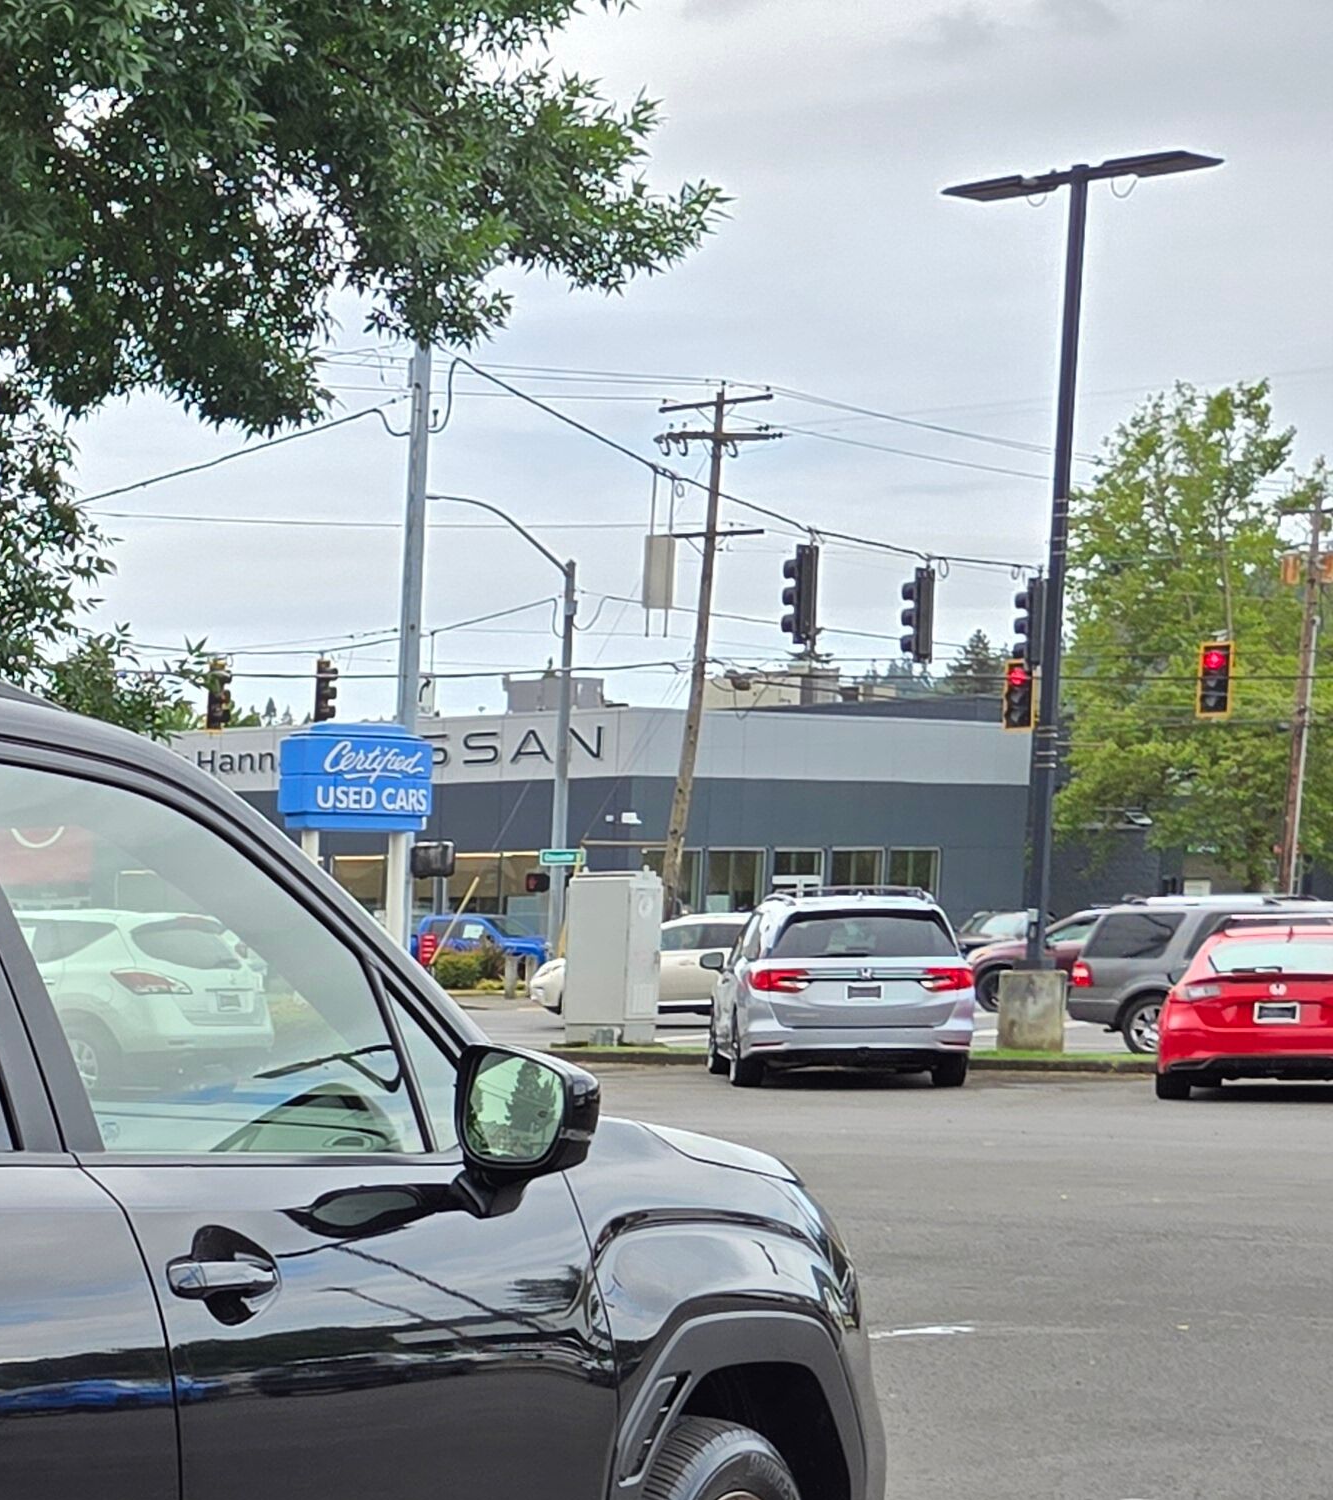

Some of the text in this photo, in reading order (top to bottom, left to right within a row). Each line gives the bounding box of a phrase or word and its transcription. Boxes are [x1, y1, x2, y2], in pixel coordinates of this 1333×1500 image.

[197, 749, 275, 773] Hann
[324, 740, 424, 784] Certified
[420, 725, 605, 766] SSAN
[316, 785, 428, 812] USED CARS
